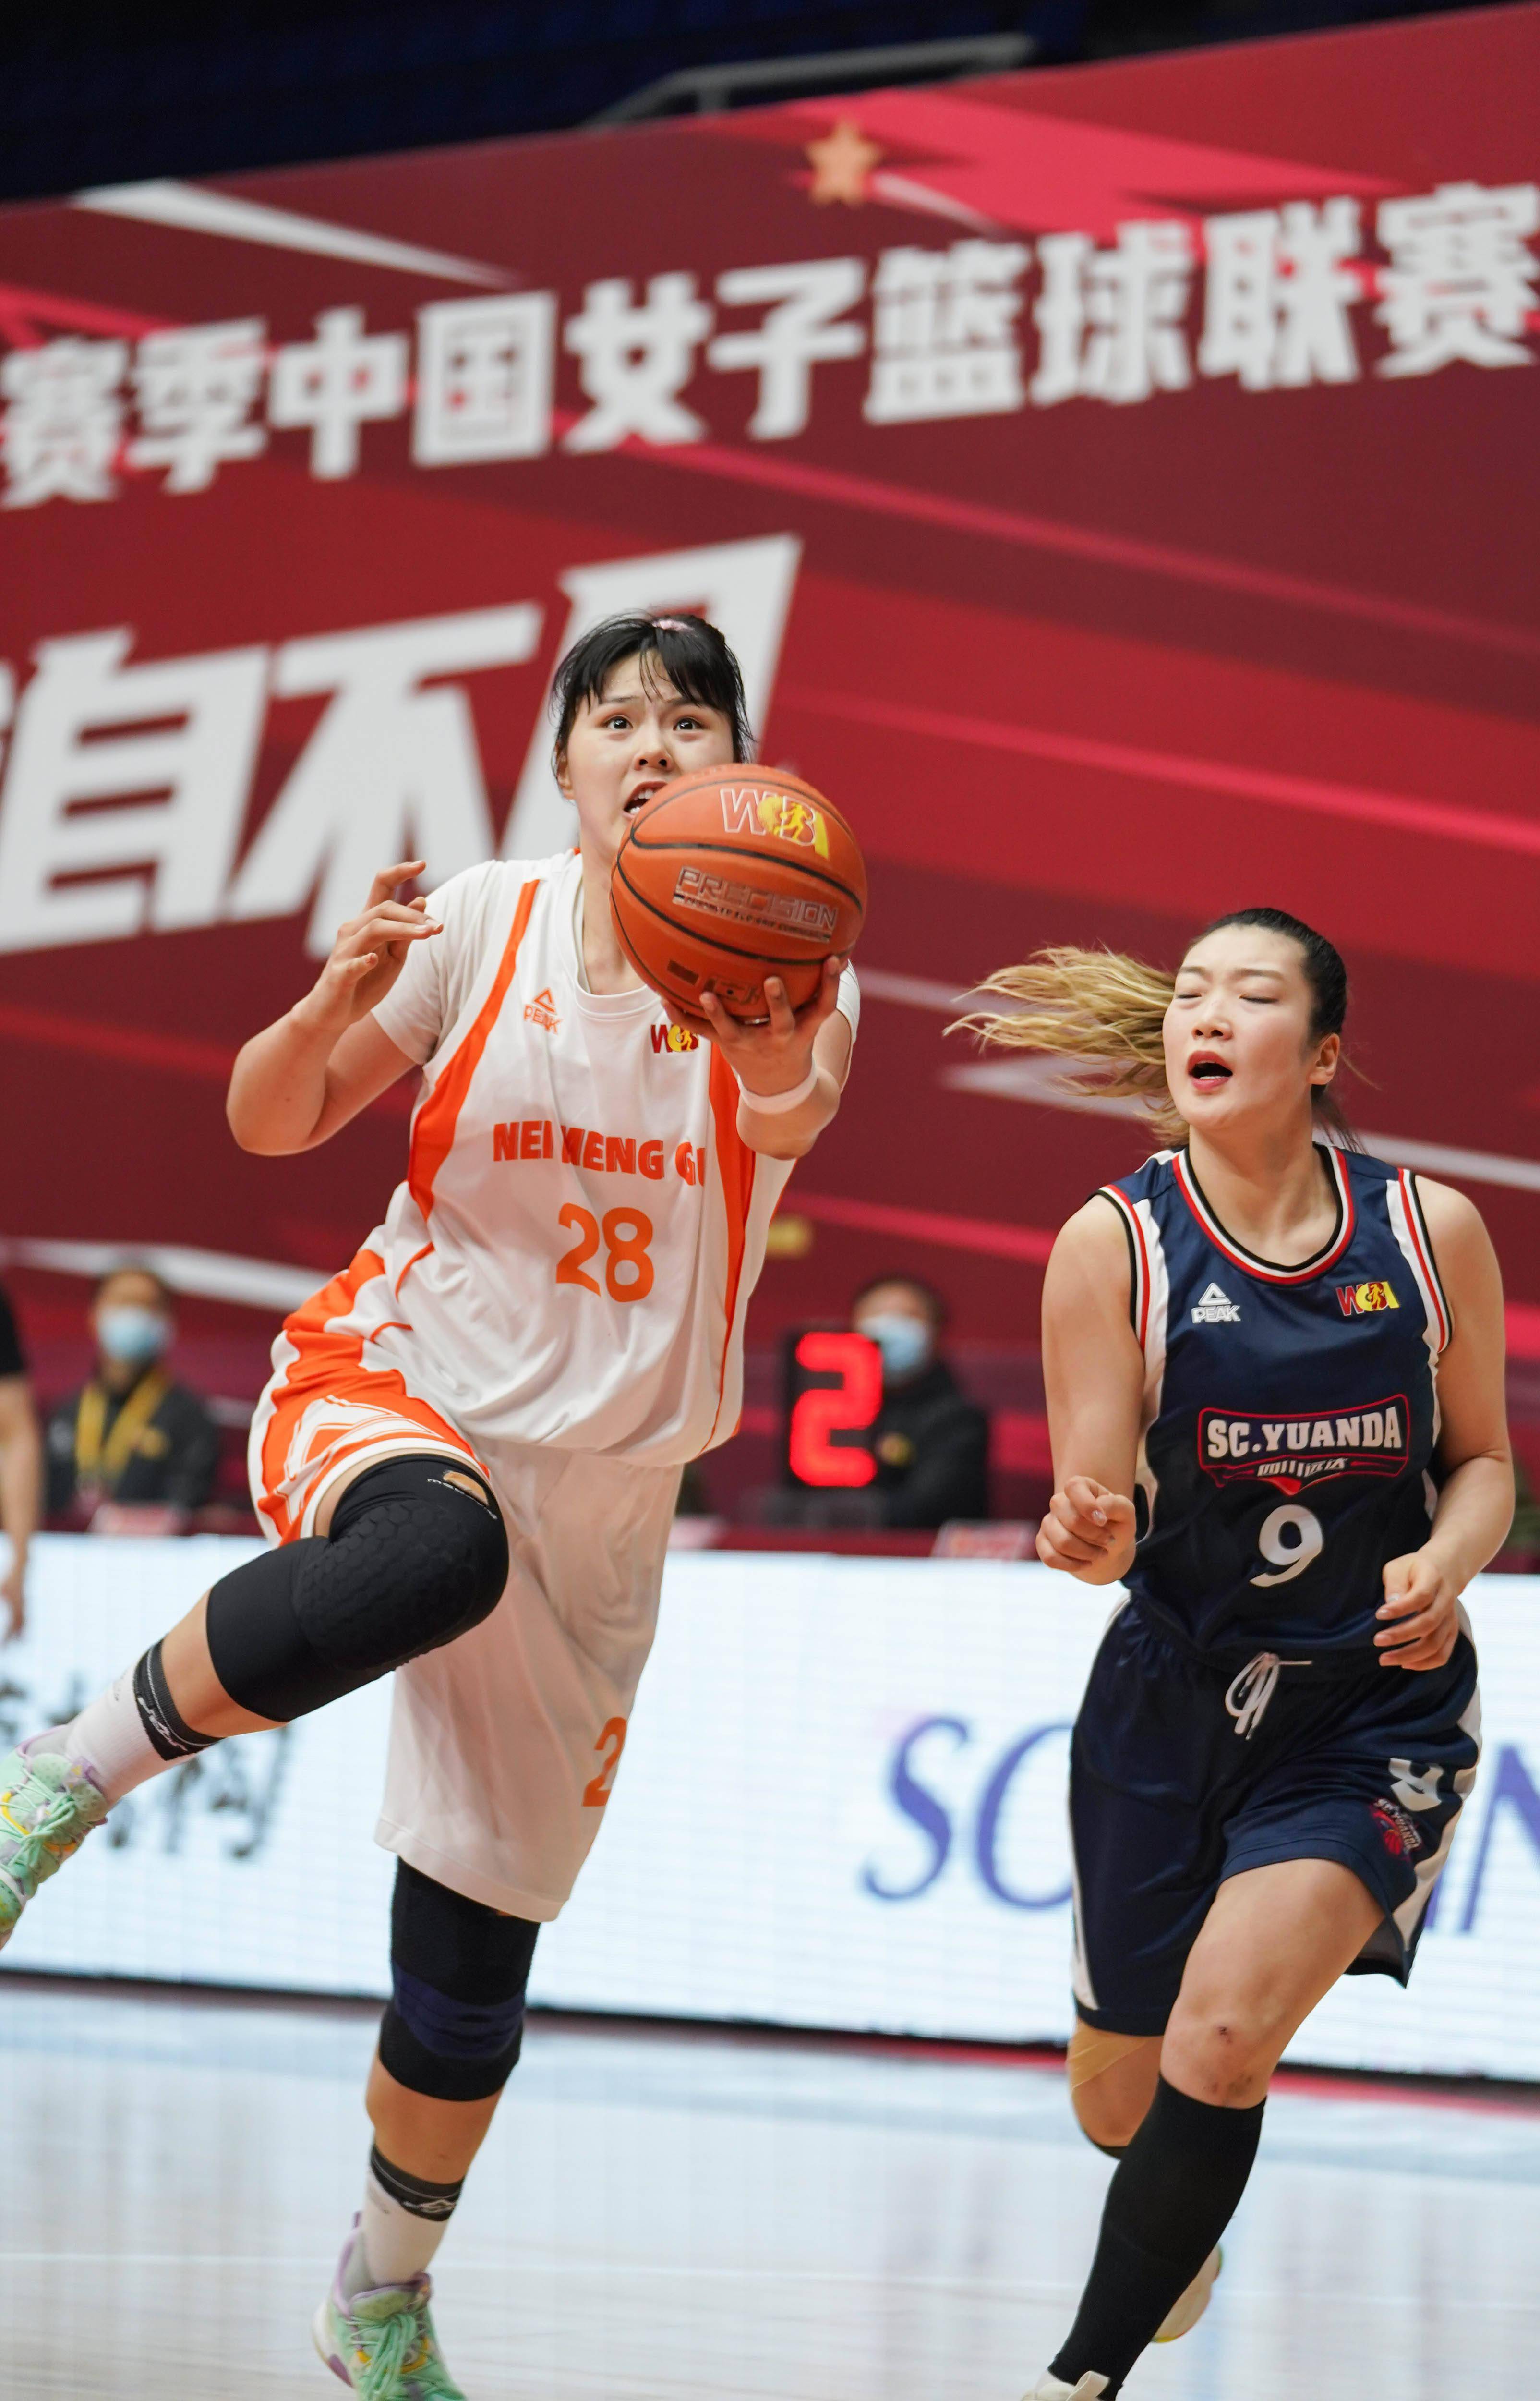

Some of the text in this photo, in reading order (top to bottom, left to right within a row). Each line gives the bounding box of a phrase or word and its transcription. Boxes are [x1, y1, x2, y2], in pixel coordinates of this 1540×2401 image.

[0, 181, 1540, 510] 赛季中国女子篮球联赛
[675, 865, 838, 930] PRECISION
[493, 1120, 553, 1162] NEI
[561, 1125, 665, 1180] MENG
[556, 1202, 654, 1302] 28
[1191, 1304, 1241, 1323] PEAK
[790, 1332, 883, 1487] 2
[1207, 1406, 1402, 1458] SC.YUANDA
[1250, 1504, 1323, 1587] 9
[582, 1716, 627, 1807] 2
